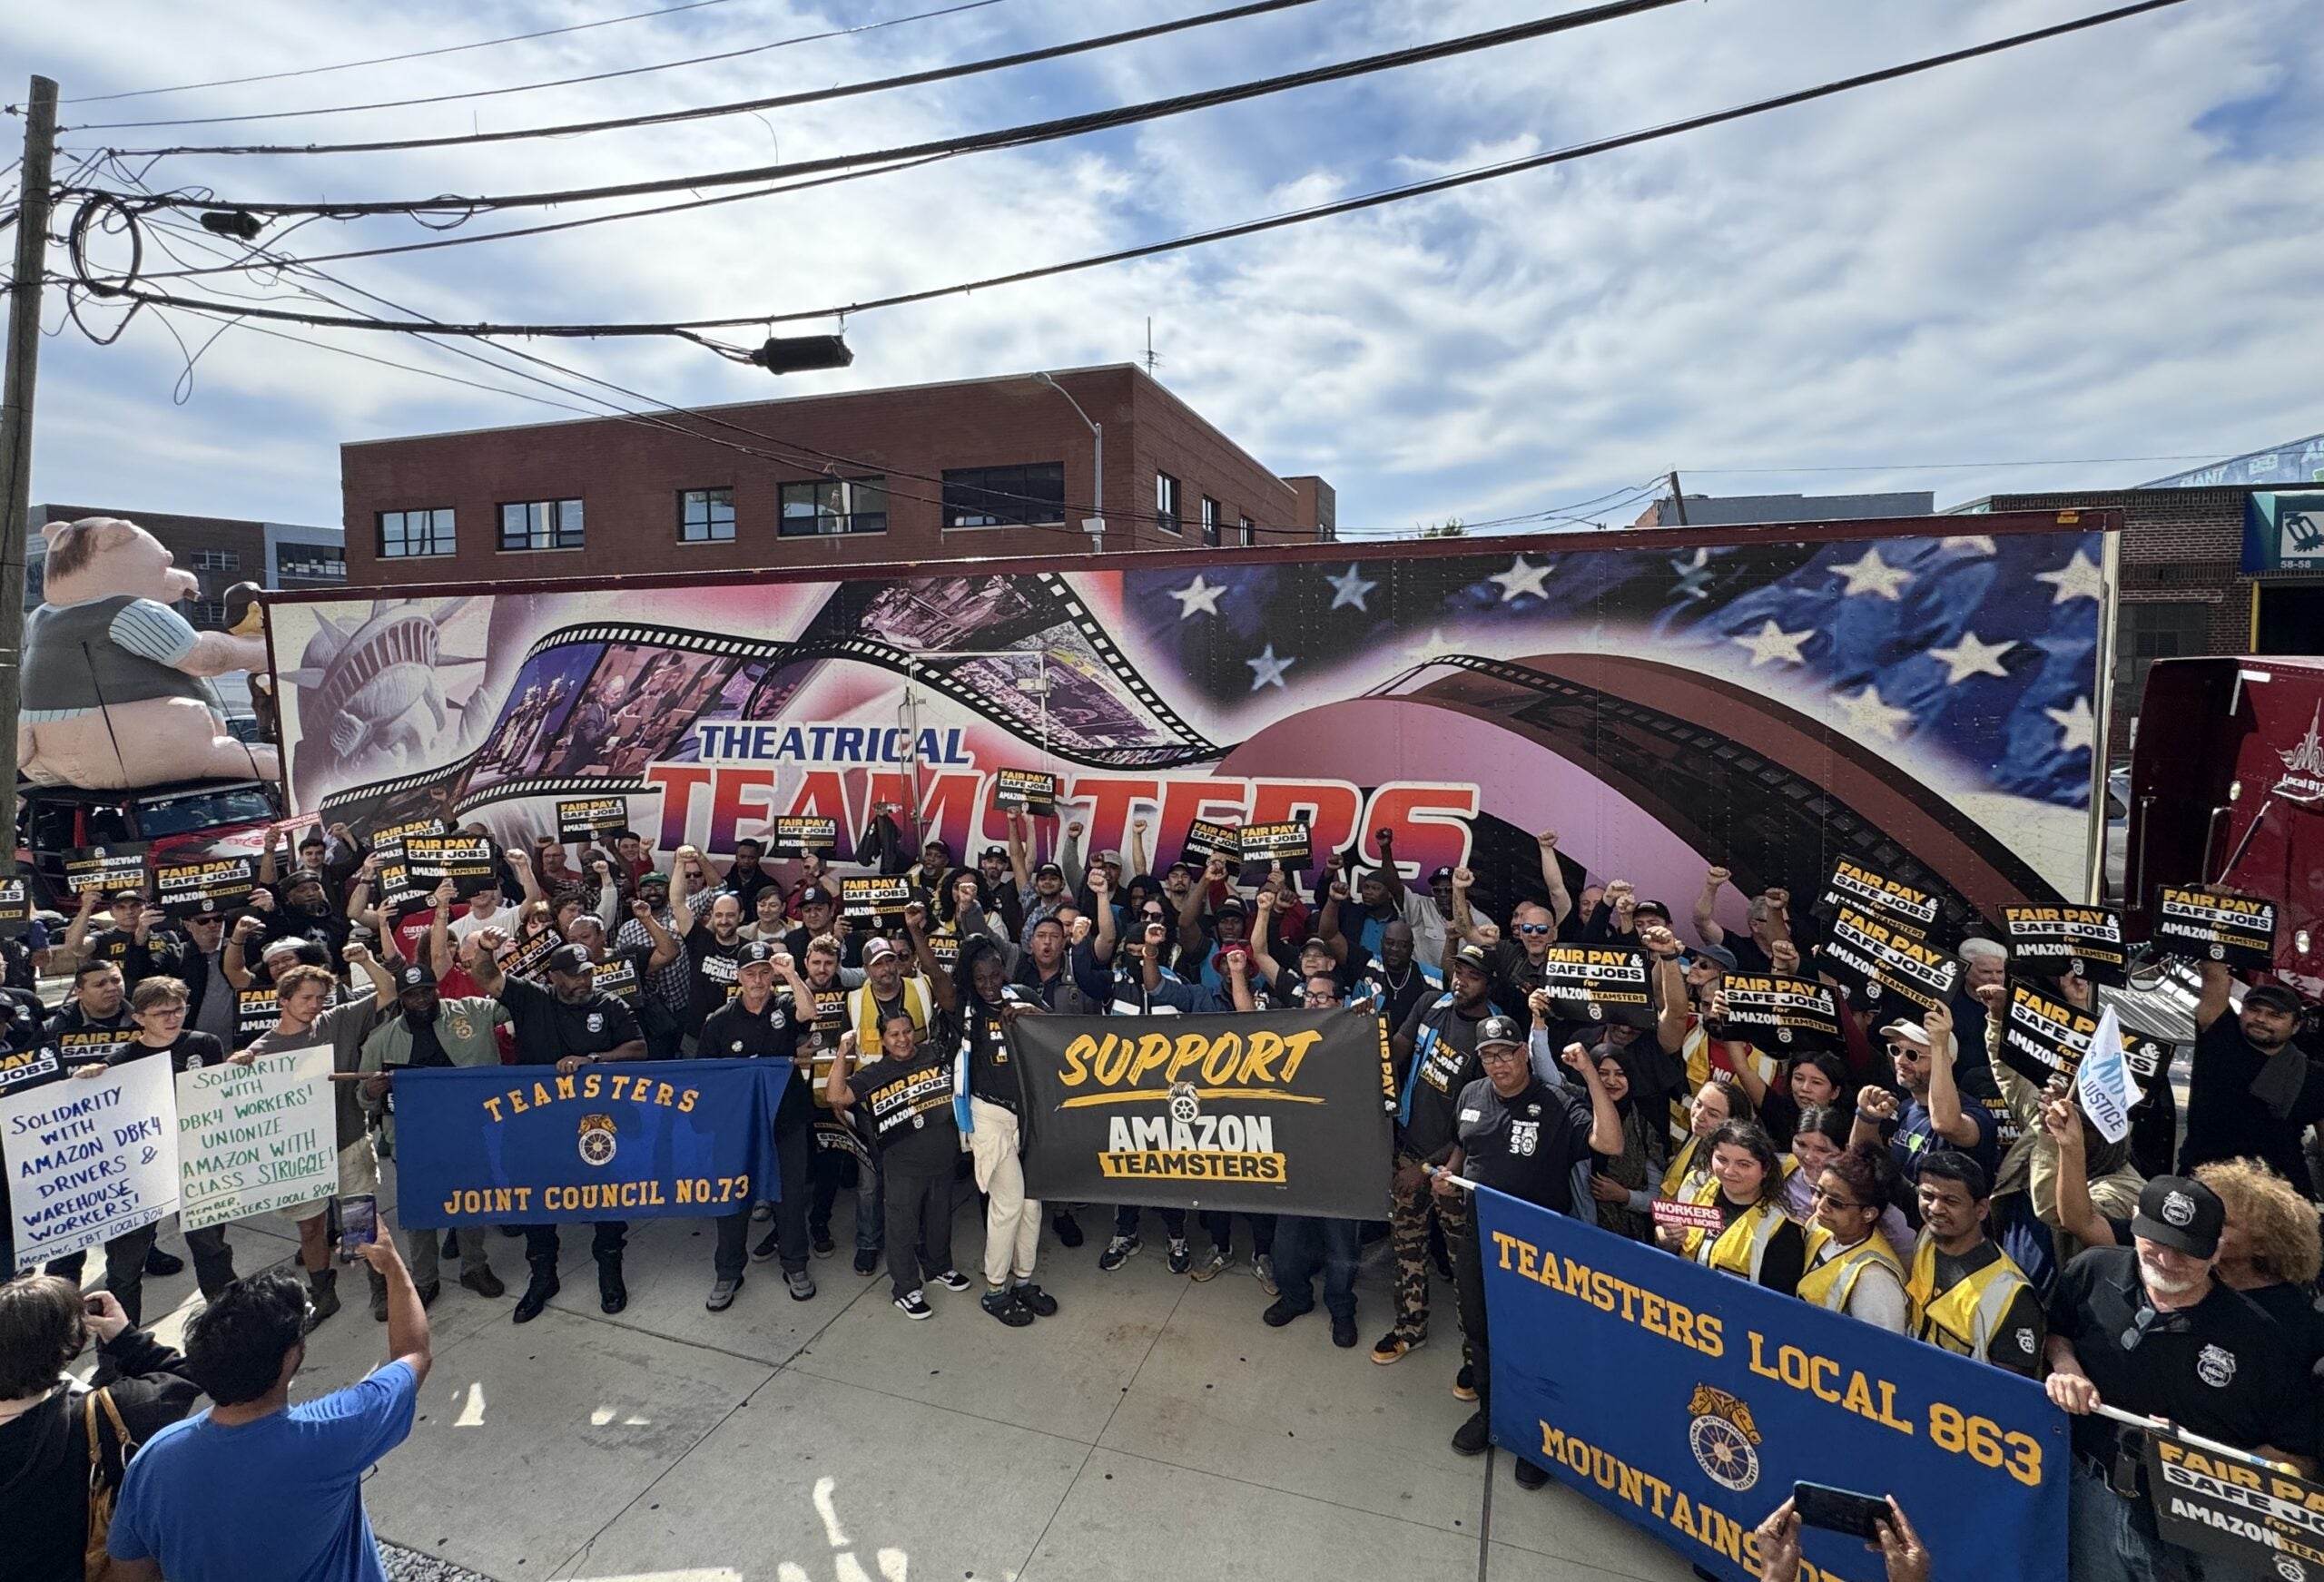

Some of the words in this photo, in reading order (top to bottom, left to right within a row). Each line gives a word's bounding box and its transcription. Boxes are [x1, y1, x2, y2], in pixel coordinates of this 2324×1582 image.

[700, 724, 970, 765] THEATRICAL
[1001, 771, 1025, 781] FAIR
[1026, 773, 1046, 782] PAY
[2282, 772, 2307, 787] Local
[561, 802, 590, 811] FAIR
[591, 800, 615, 810] PAY
[999, 791, 1027, 801] AMAZON
[373, 826, 403, 840] FAIR
[405, 820, 431, 832] PAY
[563, 823, 594, 832] AMAZON
[647, 761, 1480, 899] TEAMSTERS
[778, 819, 803, 827] FAIR
[805, 819, 827, 827] PAY
[1194, 822, 1218, 835] FAIR
[1241, 827, 1269, 837] FAIR
[1271, 824, 1296, 834] PAY
[406, 840, 441, 850] FAIR
[444, 838, 478, 850] PAY
[479, 839, 489, 849] &
[778, 839, 805, 847] AMAZON
[1243, 837, 1269, 845] SAFE
[1274, 833, 1305, 843] JOBS
[409, 850, 444, 859] SAFE
[448, 850, 487, 859] JOBS
[1244, 850, 1275, 860] AMAZON
[159, 865, 201, 879] FAIR
[203, 860, 237, 872] PAY
[240, 859, 250, 868] &
[162, 876, 202, 888] SAFE
[206, 869, 249, 881] JOBS
[411, 867, 447, 876] AMAZON
[843, 879, 869, 889] FAIR
[871, 878, 896, 889] PAY
[875, 889, 907, 899] JOBS
[1837, 861, 1882, 891] FAIR
[1885, 879, 1926, 904] PAY
[1925, 897, 1938, 909] &
[162, 890, 207, 904] AMAZON
[1835, 874, 1879, 900] SAFE
[1882, 893, 1934, 920] JOBS
[2163, 889, 2217, 907] FAIR
[2224, 898, 2261, 914] PAY
[2261, 906, 2273, 918] &
[844, 907, 875, 916] AMAZON
[2006, 909, 2060, 922] FAIR
[2063, 909, 2103, 924] PAY
[2106, 914, 2118, 928] &
[2165, 903, 2217, 919] SAFE
[2221, 911, 2270, 929] JOBS
[1839, 907, 1889, 943] FAIR
[1890, 934, 1943, 967] PAY
[1940, 960, 1958, 978] &
[2013, 922, 2066, 934] SAFE
[2070, 924, 2118, 940] JOBS
[2162, 921, 2218, 941] AMAZON
[521, 936, 545, 955] PAY
[1837, 923, 1885, 955] SAFE
[1887, 950, 1948, 988] JOBS
[2016, 944, 2074, 957] AMAZON
[1548, 948, 1585, 963] FAIR
[1588, 949, 1628, 966] PAY
[1630, 953, 1643, 968] &
[1827, 942, 1879, 979] AMAZON
[596, 969, 633, 984] JOBS
[702, 962, 738, 980] SOCIALIS
[1548, 963, 1588, 976] SAFE
[1590, 966, 1642, 981] JOBS
[815, 991, 845, 1003] PAY
[1545, 986, 1591, 1000] AMAZON
[1591, 992, 1647, 1003] TEAMSTERS
[1726, 976, 1774, 991] FAIR
[1776, 980, 1816, 996] PAY
[1820, 988, 1833, 1001] &
[1727, 991, 1777, 1003] SAFE
[1780, 995, 1833, 1014] JOBS
[1728, 1010, 1781, 1025] AMAZON
[2014, 987, 2070, 1027] FAIR
[2073, 1017, 2138, 1050] PY
[2140, 1042, 2161, 1060] &
[2014, 1007, 2070, 1042] SAFE
[61, 1033, 109, 1046] FAIR
[64, 1044, 112, 1056] SAFE
[2007, 1028, 2061, 1071] AMAZON
[39, 1046, 54, 1059] &
[1059, 1029, 1324, 1087] SUPPORT
[192, 1055, 298, 1091] SOLIDARITY
[219, 1079, 263, 1100] WITH
[871, 1078, 906, 1105] FAIR
[907, 1066, 940, 1086] PAY
[875, 1091, 911, 1113] SAFE
[915, 1074, 951, 1095] JOBS
[180, 1108, 223, 1134] DBK4
[233, 1083, 313, 1120] WORKERS!
[481, 1074, 701, 1124] TEAMSTERS
[2083, 1080, 2125, 1132] JUSTICE
[11, 1086, 123, 1136] SOLIDARITY
[879, 1105, 915, 1134] AMAZON
[40, 1117, 95, 1147] WITH
[201, 1115, 283, 1151] UNIONIZE
[1108, 1114, 1275, 1154] AMAZON
[21, 1136, 104, 1178] AMAZON
[113, 1115, 163, 1148] DBK4
[182, 1146, 261, 1180] AMAZON
[269, 1127, 317, 1158] WITH
[36, 1154, 127, 1200] DRIVERS
[141, 1145, 159, 1165] &
[184, 1171, 244, 1200] CLASS
[257, 1145, 334, 1184] STRUGGLE!
[1108, 1153, 1279, 1179] TEAMSTERS
[23, 1177, 134, 1227] WAREHOUSE
[443, 1186, 532, 1215] JOINT
[545, 1179, 665, 1210] COUNCIL
[675, 1174, 750, 1204] NO.73
[28, 1192, 141, 1243] WORKERS!
[186, 1198, 272, 1231] TEAMSTERS
[276, 1190, 310, 1207] LOCAL
[312, 1182, 337, 1198] 804
[1653, 1201, 1720, 1221] WORKERS
[77, 1229, 103, 1249] IBT
[143, 1206, 165, 1225] 804
[1655, 1213, 1695, 1226] DESERVE
[1695, 1215, 1721, 1230] MORE
[1492, 1230, 1725, 1359] TEAMSTERS
[1748, 1330, 1915, 1436] LOCAL
[1929, 1401, 2044, 1488] 863
[2159, 1439, 2262, 1492] FAIR
[2167, 1464, 2270, 1511] SAFE
[2171, 1497, 2281, 1548] AMAZON
